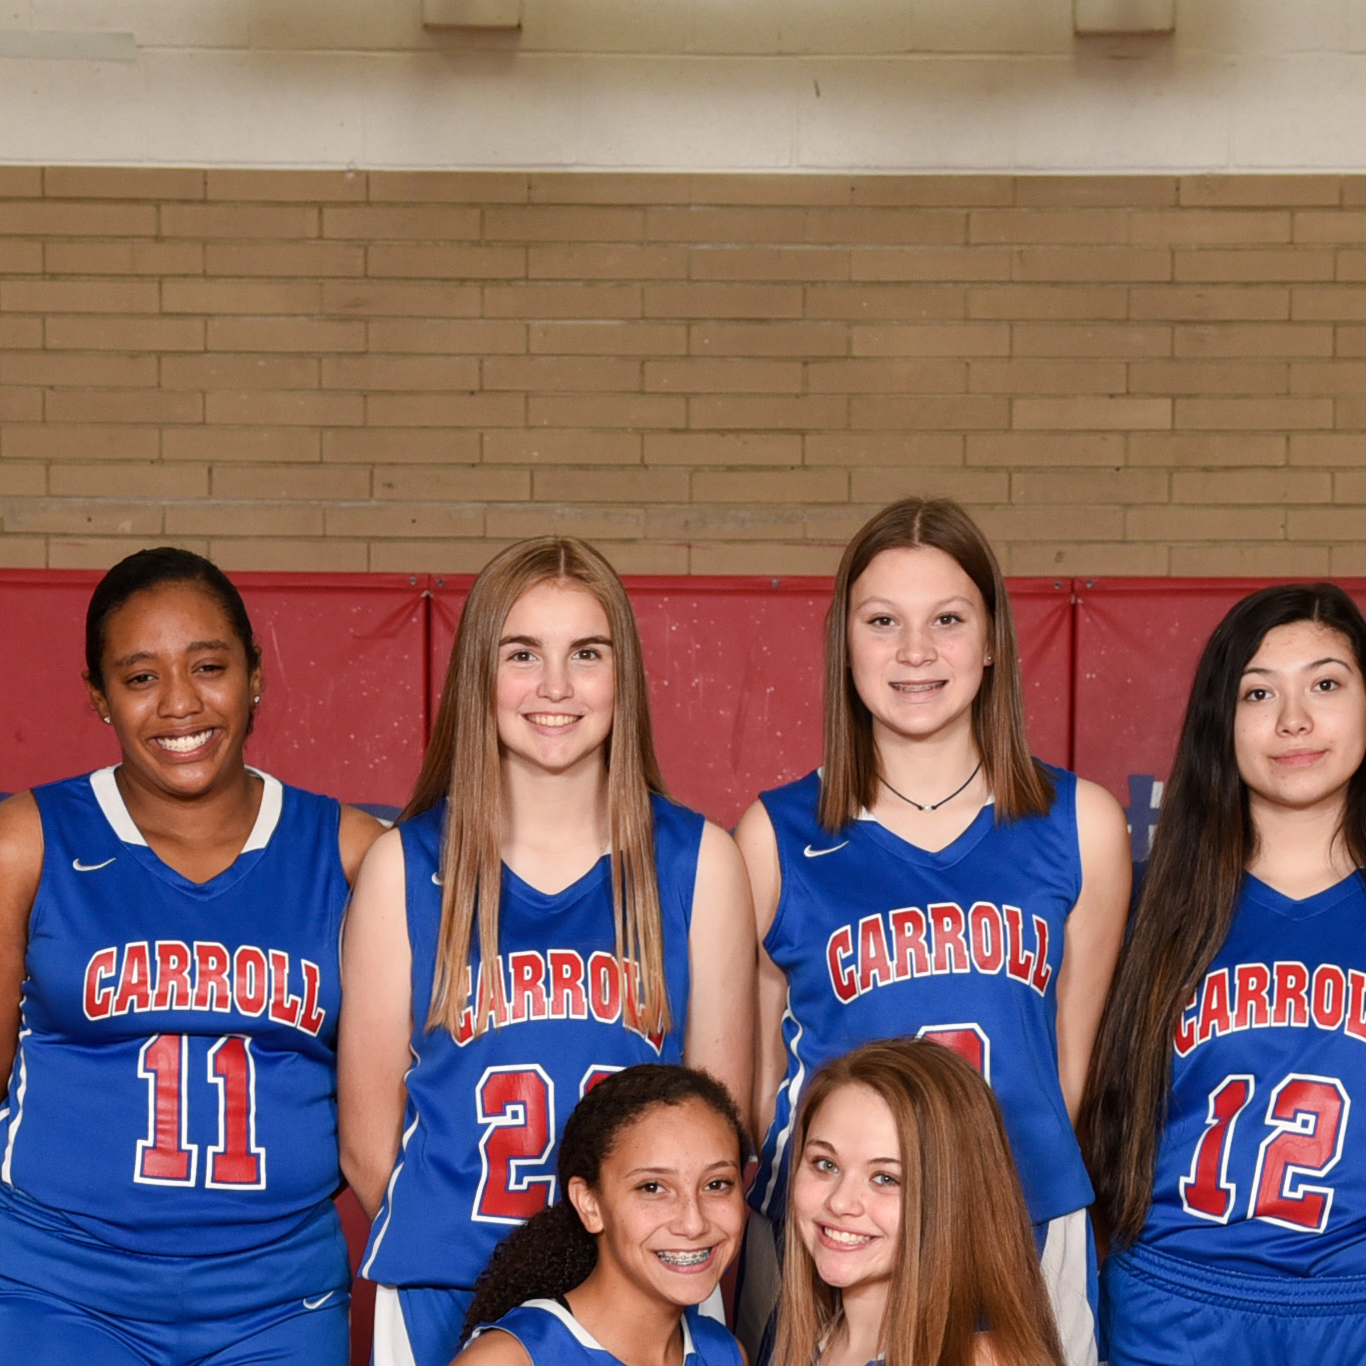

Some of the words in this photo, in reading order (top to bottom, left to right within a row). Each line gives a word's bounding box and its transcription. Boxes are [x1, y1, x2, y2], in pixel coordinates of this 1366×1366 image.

[82, 940, 326, 1036] CARROLL
[826, 901, 1052, 1005] CARROLL
[135, 1032, 265, 1190] 11
[1178, 1073, 1350, 1233] 12
